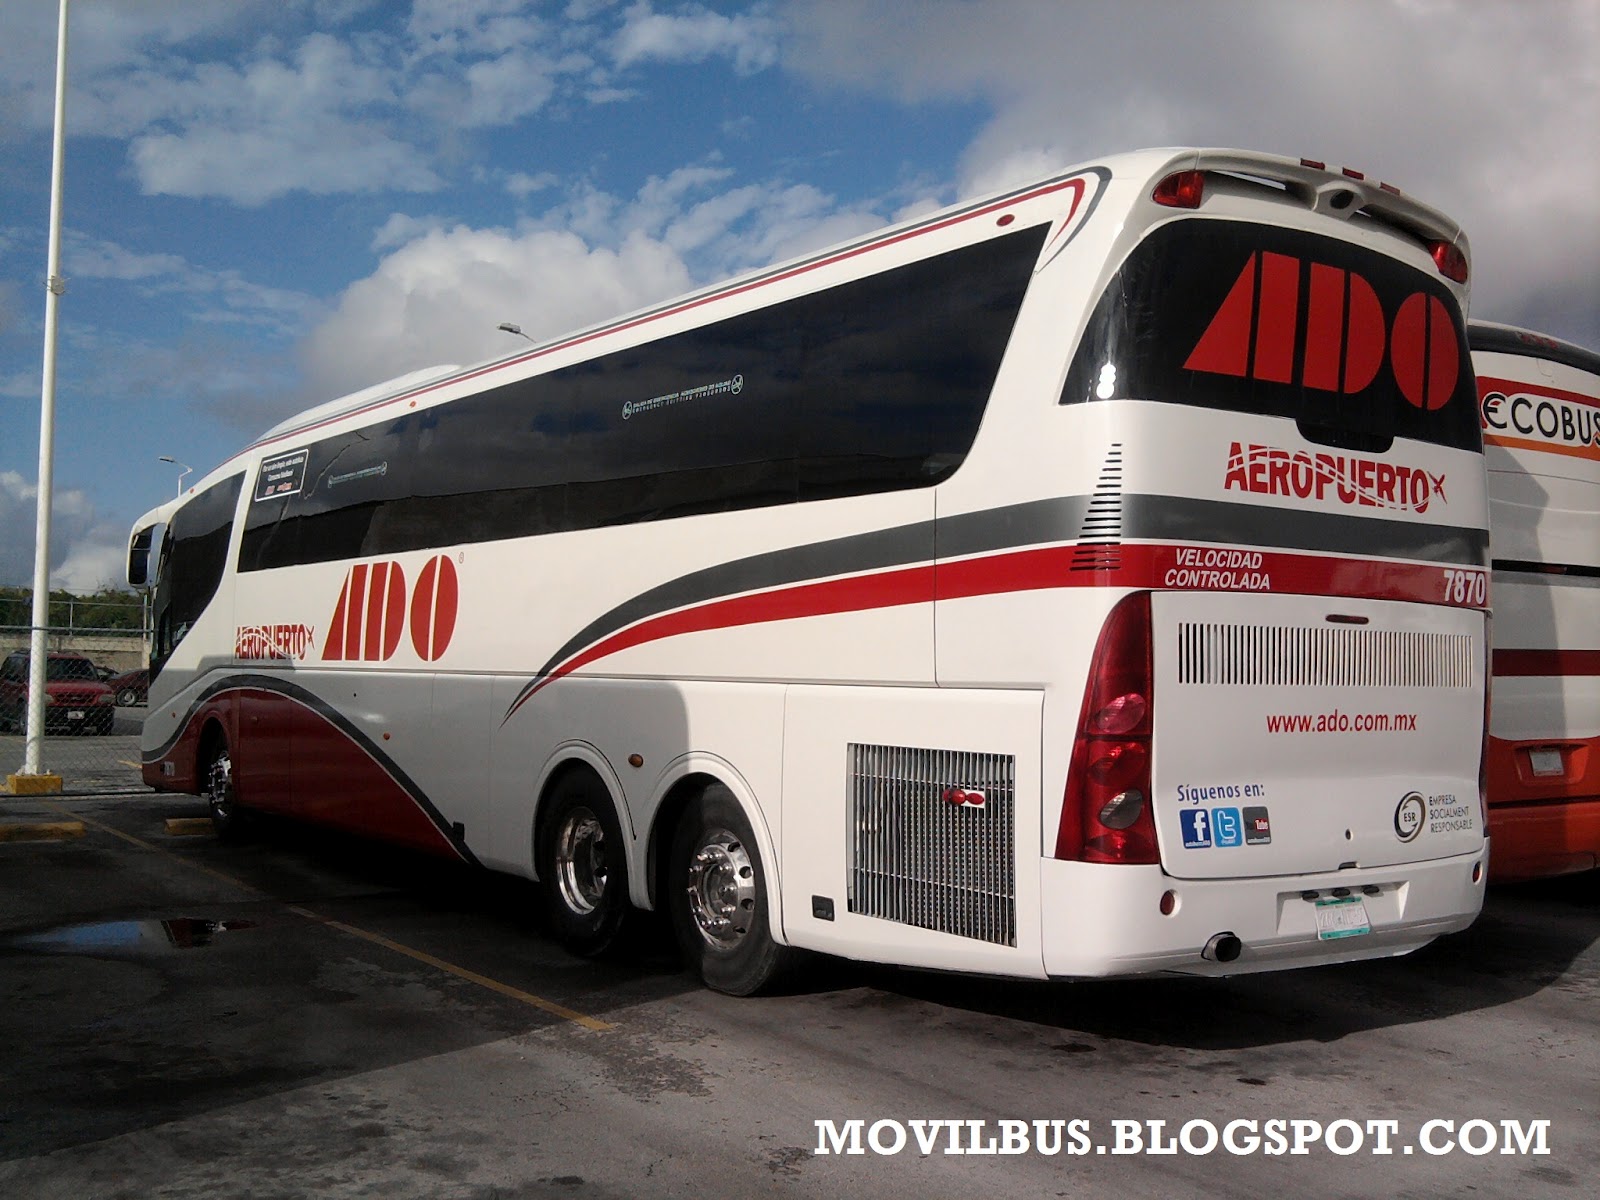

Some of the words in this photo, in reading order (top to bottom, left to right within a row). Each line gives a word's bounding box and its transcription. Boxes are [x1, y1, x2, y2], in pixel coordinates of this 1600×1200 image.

[1182, 250, 1460, 411] ADO
[1224, 442, 1430, 514] AEROPUERTO
[1174, 548, 1263, 570] VELOCIDAD
[1164, 568, 1271, 590] CONTROLADA
[1443, 569, 1487, 605] 7870
[321, 554, 459, 662] ADO
[234, 623, 306, 661] AEROPUERTO
[1266, 708, 1418, 733] www.ado.com.mx
[1177, 784, 1240, 805] Síguenos
[1244, 784, 1265, 797] en:
[1428, 794, 1457, 806] EMPRESA
[1403, 812, 1417, 823] ESR
[1430, 819, 1473, 833] RESPONSABLE
